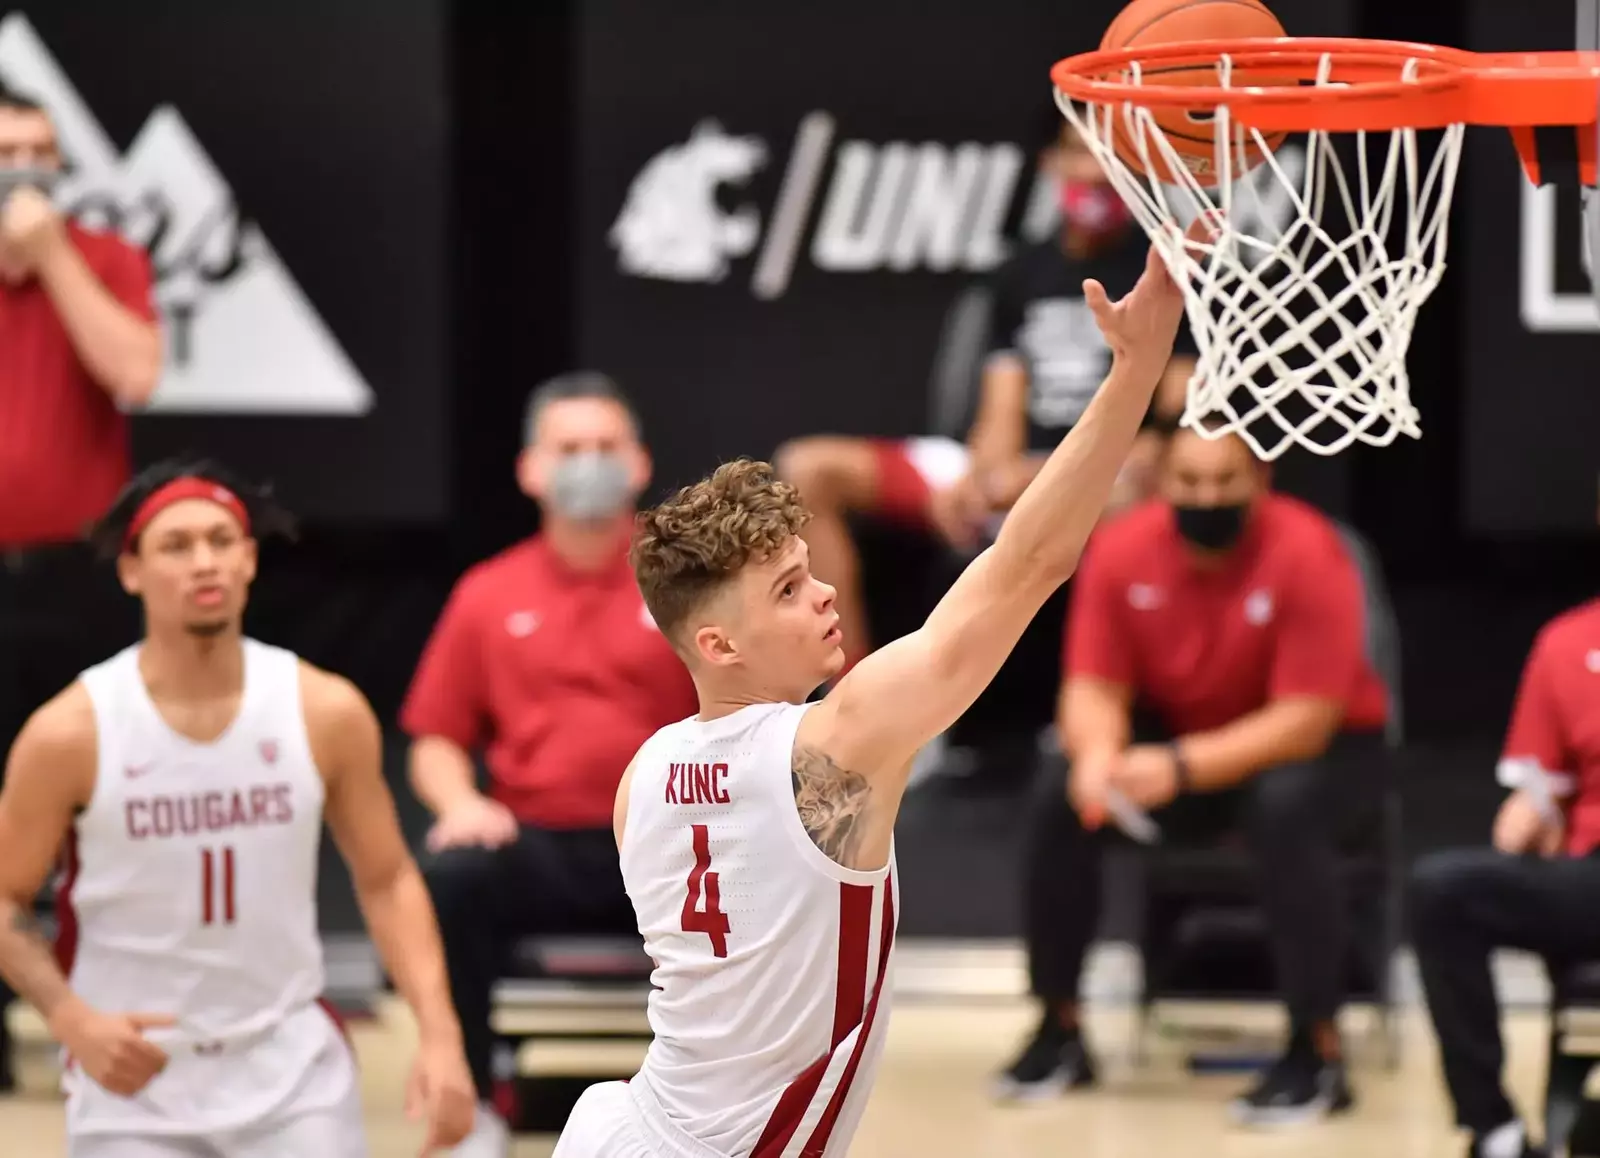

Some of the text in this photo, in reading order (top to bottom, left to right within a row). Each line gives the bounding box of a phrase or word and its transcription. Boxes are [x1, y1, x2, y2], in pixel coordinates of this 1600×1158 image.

[125, 782, 293, 840] COUGARS
[665, 763, 730, 804] KUNC
[200, 846, 236, 926] 11
[681, 825, 731, 958] 4
